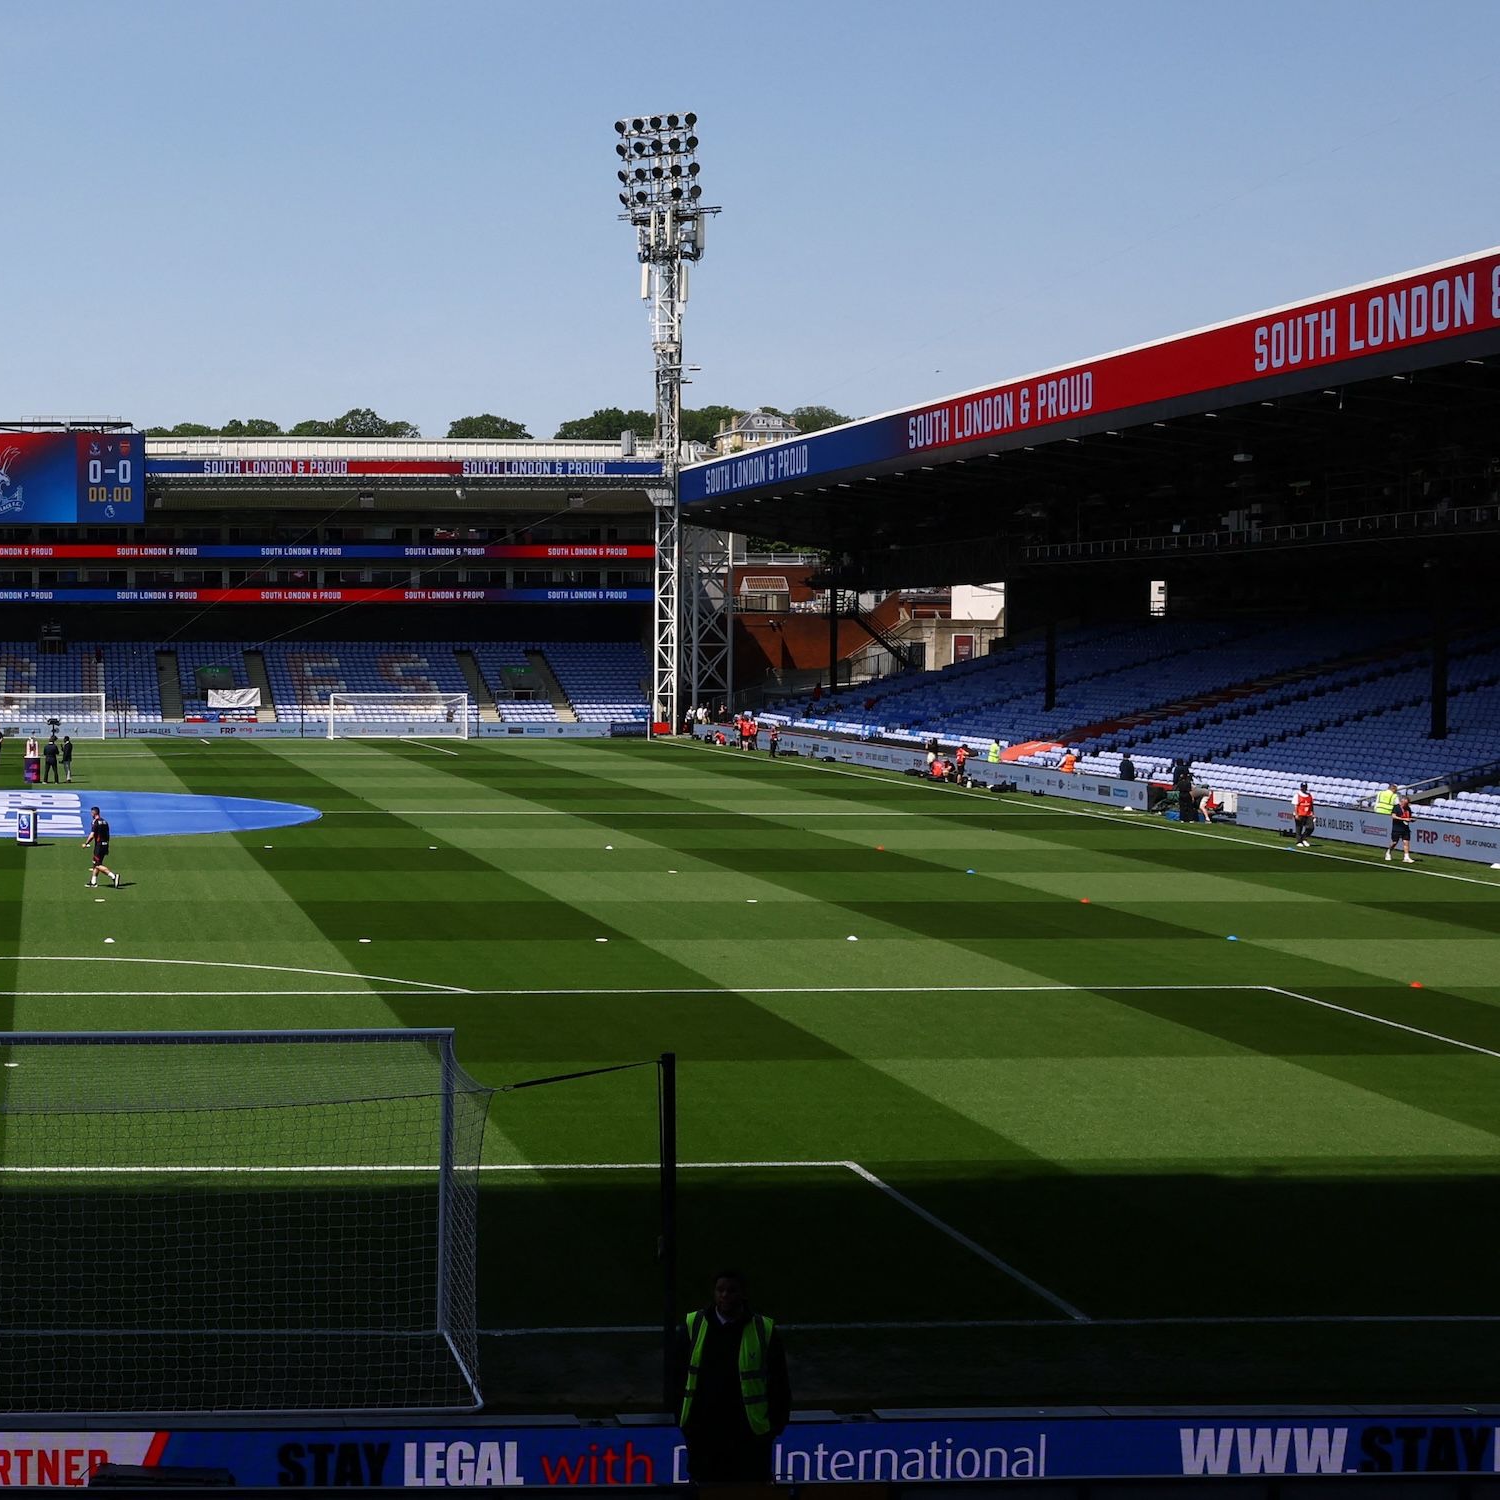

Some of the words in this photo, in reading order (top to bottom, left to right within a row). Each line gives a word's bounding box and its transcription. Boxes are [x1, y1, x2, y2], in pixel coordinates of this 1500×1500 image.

[1254, 308, 1336, 372] SOUTH
[1349, 272, 1475, 352] LONDON
[908, 408, 949, 449] SOUTH
[955, 391, 1014, 439] LONDON
[1020, 387, 1030, 424] &
[1037, 371, 1093, 420] PROUD
[89, 460, 131, 483] 0-0
[203, 461, 241, 474] SOUTH
[245, 461, 292, 474] LONDON
[297, 461, 305, 474] &
[310, 461, 348, 474] PROUD
[463, 462, 499, 474] SOUTH
[505, 462, 550, 474] LONDON
[555, 462, 562, 474] &
[568, 462, 606, 474] PROUD
[706, 461, 730, 495] SOUTH
[732, 456, 765, 488] LONDON
[768, 454, 774, 481] &
[778, 444, 808, 479] PROUD
[89, 487, 131, 502] 00:00
[31, 548, 53, 556] PROUD
[118, 548, 139, 556] SOUTH
[140, 548, 167, 556] LONDON
[176, 548, 198, 556] PROUD
[262, 548, 283, 556] SOUTH
[284, 548, 311, 556] LONDON
[320, 548, 342, 556] PROUD
[405, 548, 426, 556] SOUTH
[427, 548, 454, 556] LONDON
[548, 548, 568, 556] SOUTH
[570, 548, 597, 556] LONDON
[605, 548, 627, 556] PROUD
[405, 591, 426, 599] SOUTH
[427, 591, 454, 599] LONDON
[548, 591, 568, 599] SOUTH
[570, 591, 597, 599] LONDON
[605, 591, 627, 599] PROUD
[1328, 819, 1354, 832] HOLDERS
[1416, 829, 1438, 844] FRP
[1443, 834, 1461, 847] ersg
[278, 1442, 390, 1486] STAY
[403, 1440, 524, 1486] LEGAL
[541, 1439, 654, 1484] with
[774, 1432, 1047, 1482] International
